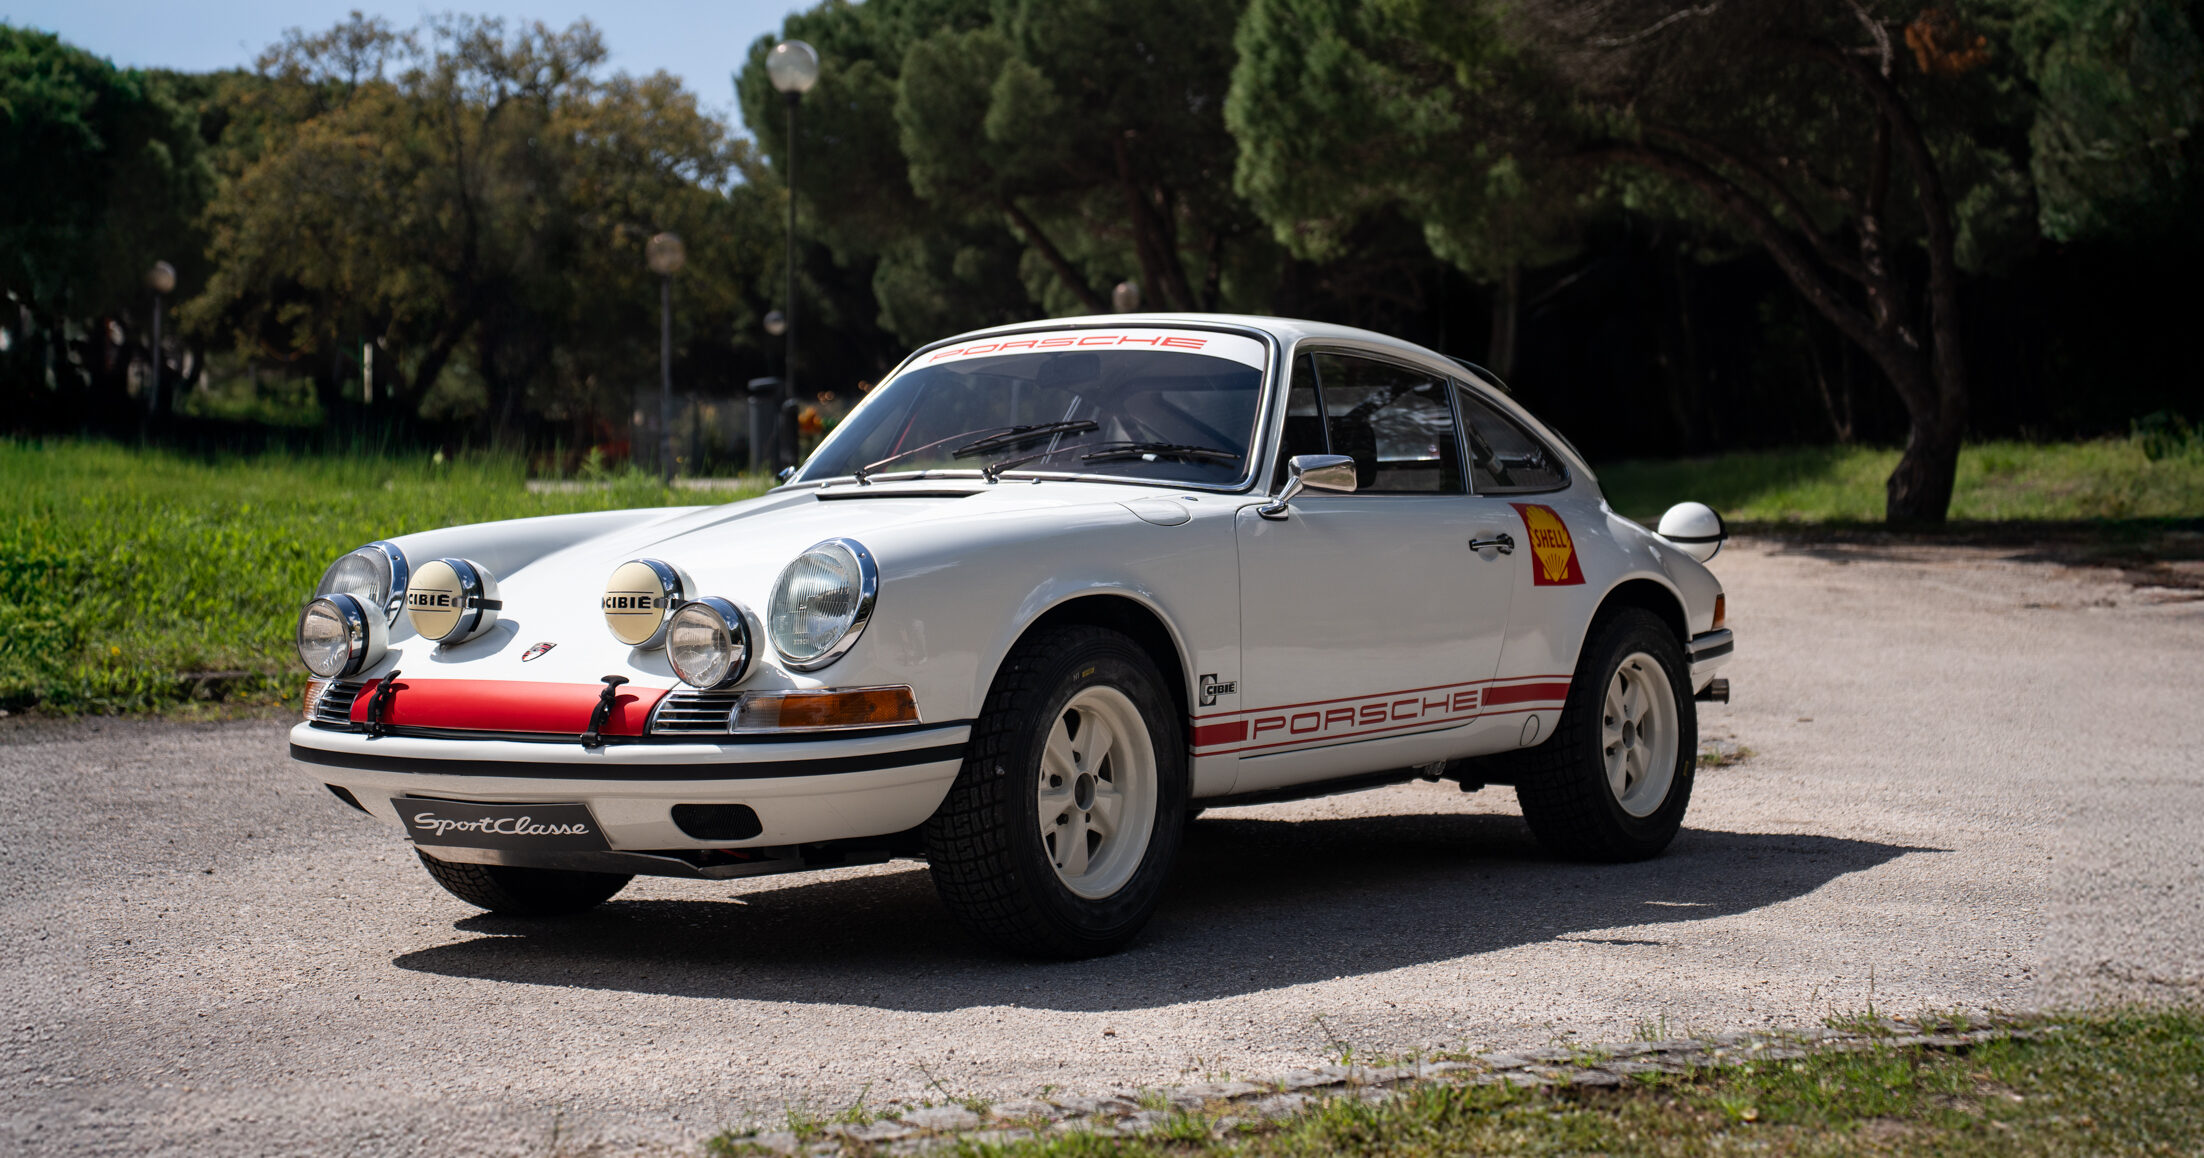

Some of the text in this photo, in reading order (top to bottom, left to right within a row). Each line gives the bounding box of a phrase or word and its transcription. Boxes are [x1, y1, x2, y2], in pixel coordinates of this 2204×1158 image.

[929, 335, 1208, 363] PORSCHE
[1534, 528, 1567, 548] SHELL
[1252, 690, 1479, 740] PORSCHE
